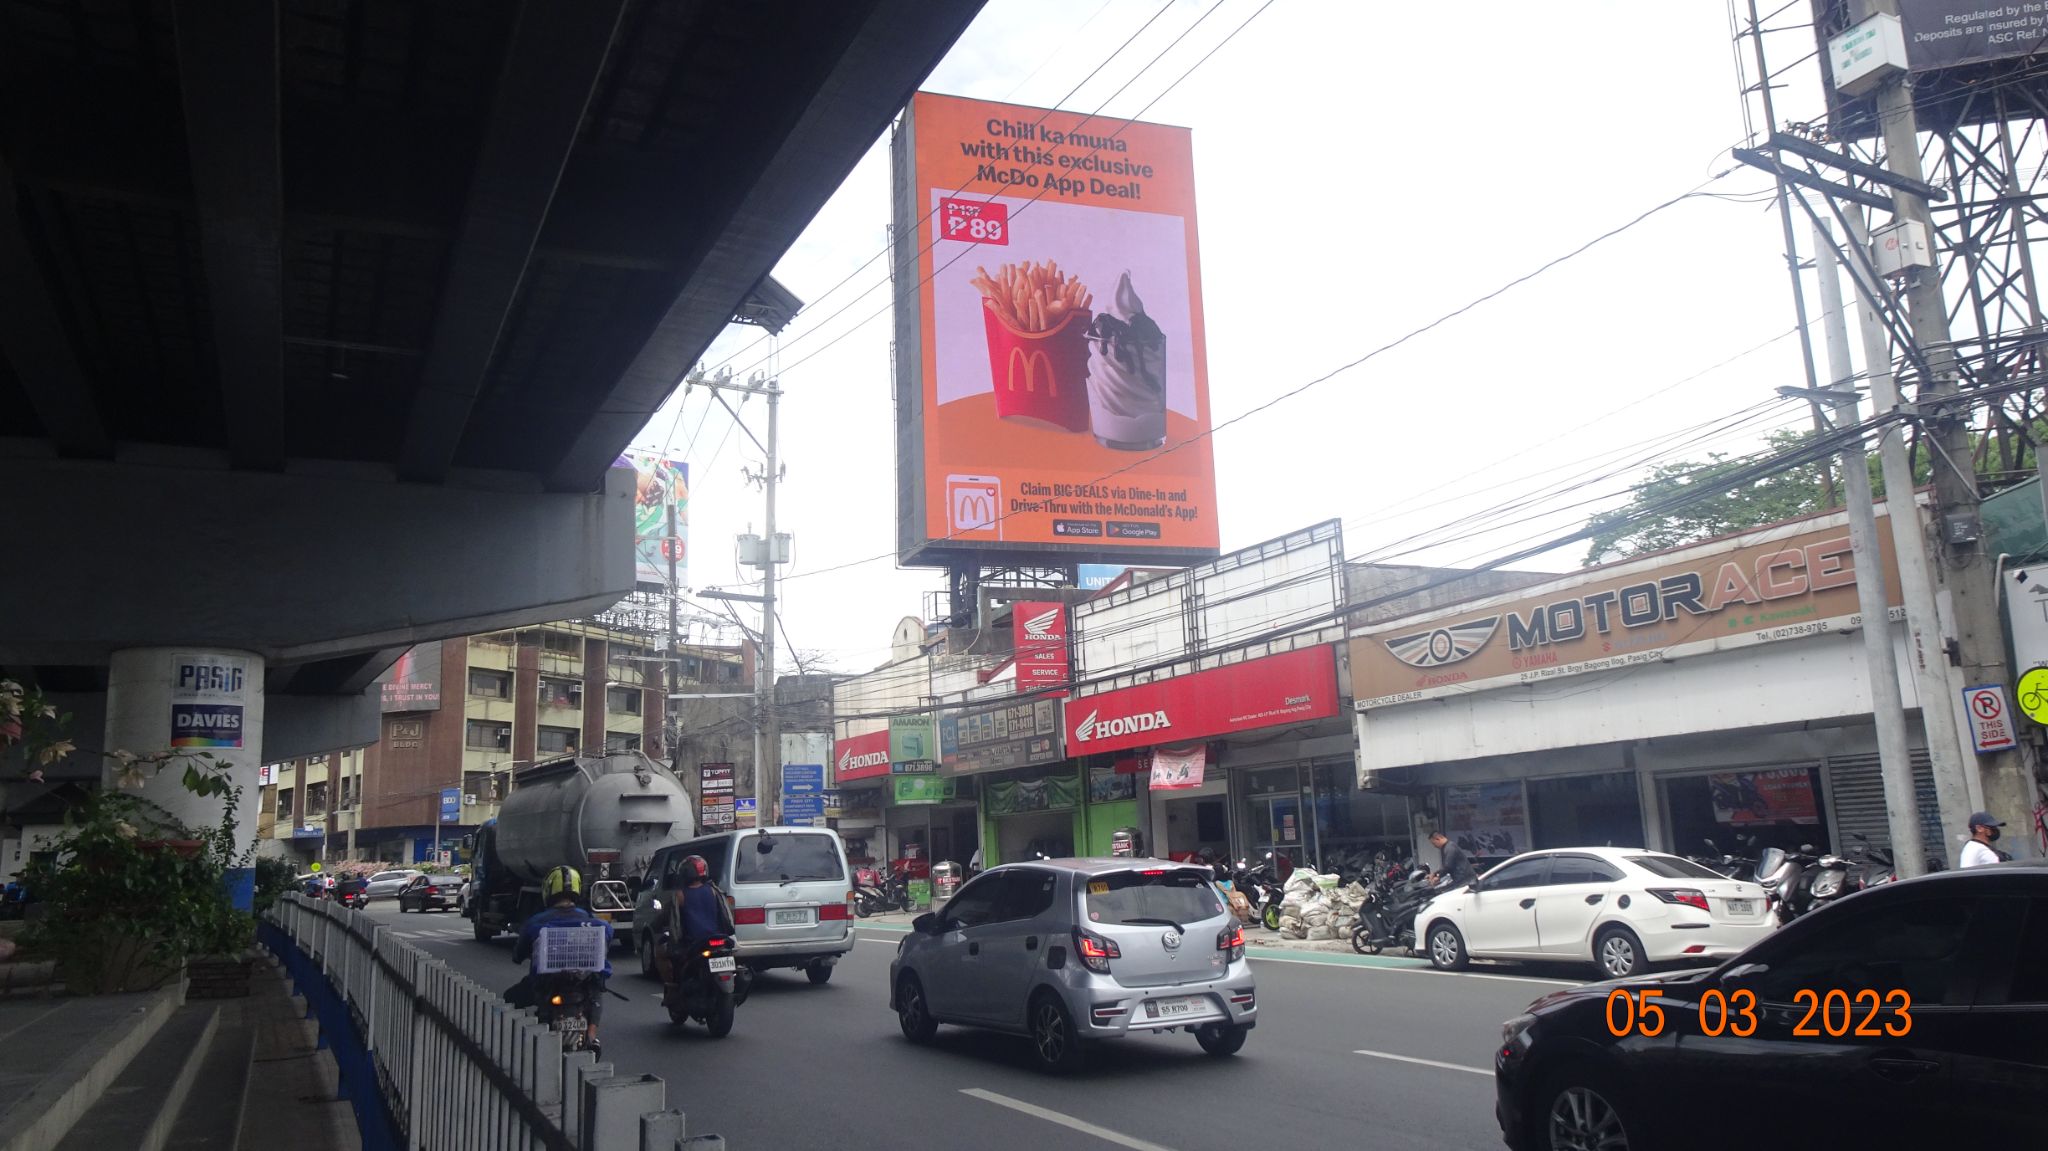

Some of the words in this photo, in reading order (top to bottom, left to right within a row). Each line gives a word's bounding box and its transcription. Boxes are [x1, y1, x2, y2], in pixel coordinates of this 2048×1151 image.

[1945, 7, 2003, 24] Regulated
[2006, 6, 2020, 17] by
[2023, 3, 2041, 13] the
[1914, 27, 1963, 43] Deposits
[1965, 24, 1983, 35] are
[2030, 15, 2044, 26] by
[1988, 32, 2013, 44] ASC
[2016, 30, 2040, 40] Ref.
[987, 119, 1035, 141] Chill
[1040, 125, 1066, 144] ka
[1069, 131, 1127, 152] muna
[961, 140, 1010, 161] with
[1013, 145, 1054, 166] this
[1059, 154, 1153, 178] exclusive
[977, 165, 1038, 188] McDo
[1043, 173, 1085, 197] App
[1090, 177, 1141, 200] Deal!
[1020, 482, 1051, 497] Claim
[1053, 484, 1073, 498] BIG
[1075, 485, 1108, 499] DEALS
[1111, 488, 1126, 500] via
[1128, 487, 1166, 501] Dine-In
[1168, 489, 1187, 502] and
[1011, 498, 1067, 513] Drive-Thru
[1070, 501, 1093, 514] with
[1095, 501, 1112, 515] the
[1114, 502, 1173, 517] McDonald's
[1175, 505, 1198, 519] App!
[1081, 526, 1099, 534] Store
[1122, 528, 1144, 536] Google
[1756, 632, 1771, 641] Tel.
[1523, 653, 1558, 668] YAMAHA
[1541, 669, 1557, 677] Rizal
[1568, 665, 1583, 674] Brgy
[1584, 660, 1610, 671] Bagong
[1627, 653, 1647, 663] Pasig
[1648, 650, 1664, 660] City
[411, 682, 433, 690] MERCY
[1427, 671, 1468, 686] HONDA
[1357, 695, 1396, 708] MOTORCYCLE
[1397, 691, 1423, 702] DEALER
[177, 713, 240, 728] DAVIES
[893, 718, 930, 727] AMARON
[1094, 710, 1172, 740] HONDA
[1978, 720, 2004, 730] THIS
[393, 723, 420, 737] P&J
[1981, 729, 2006, 739] SIDE
[849, 750, 889, 770] HONDA
